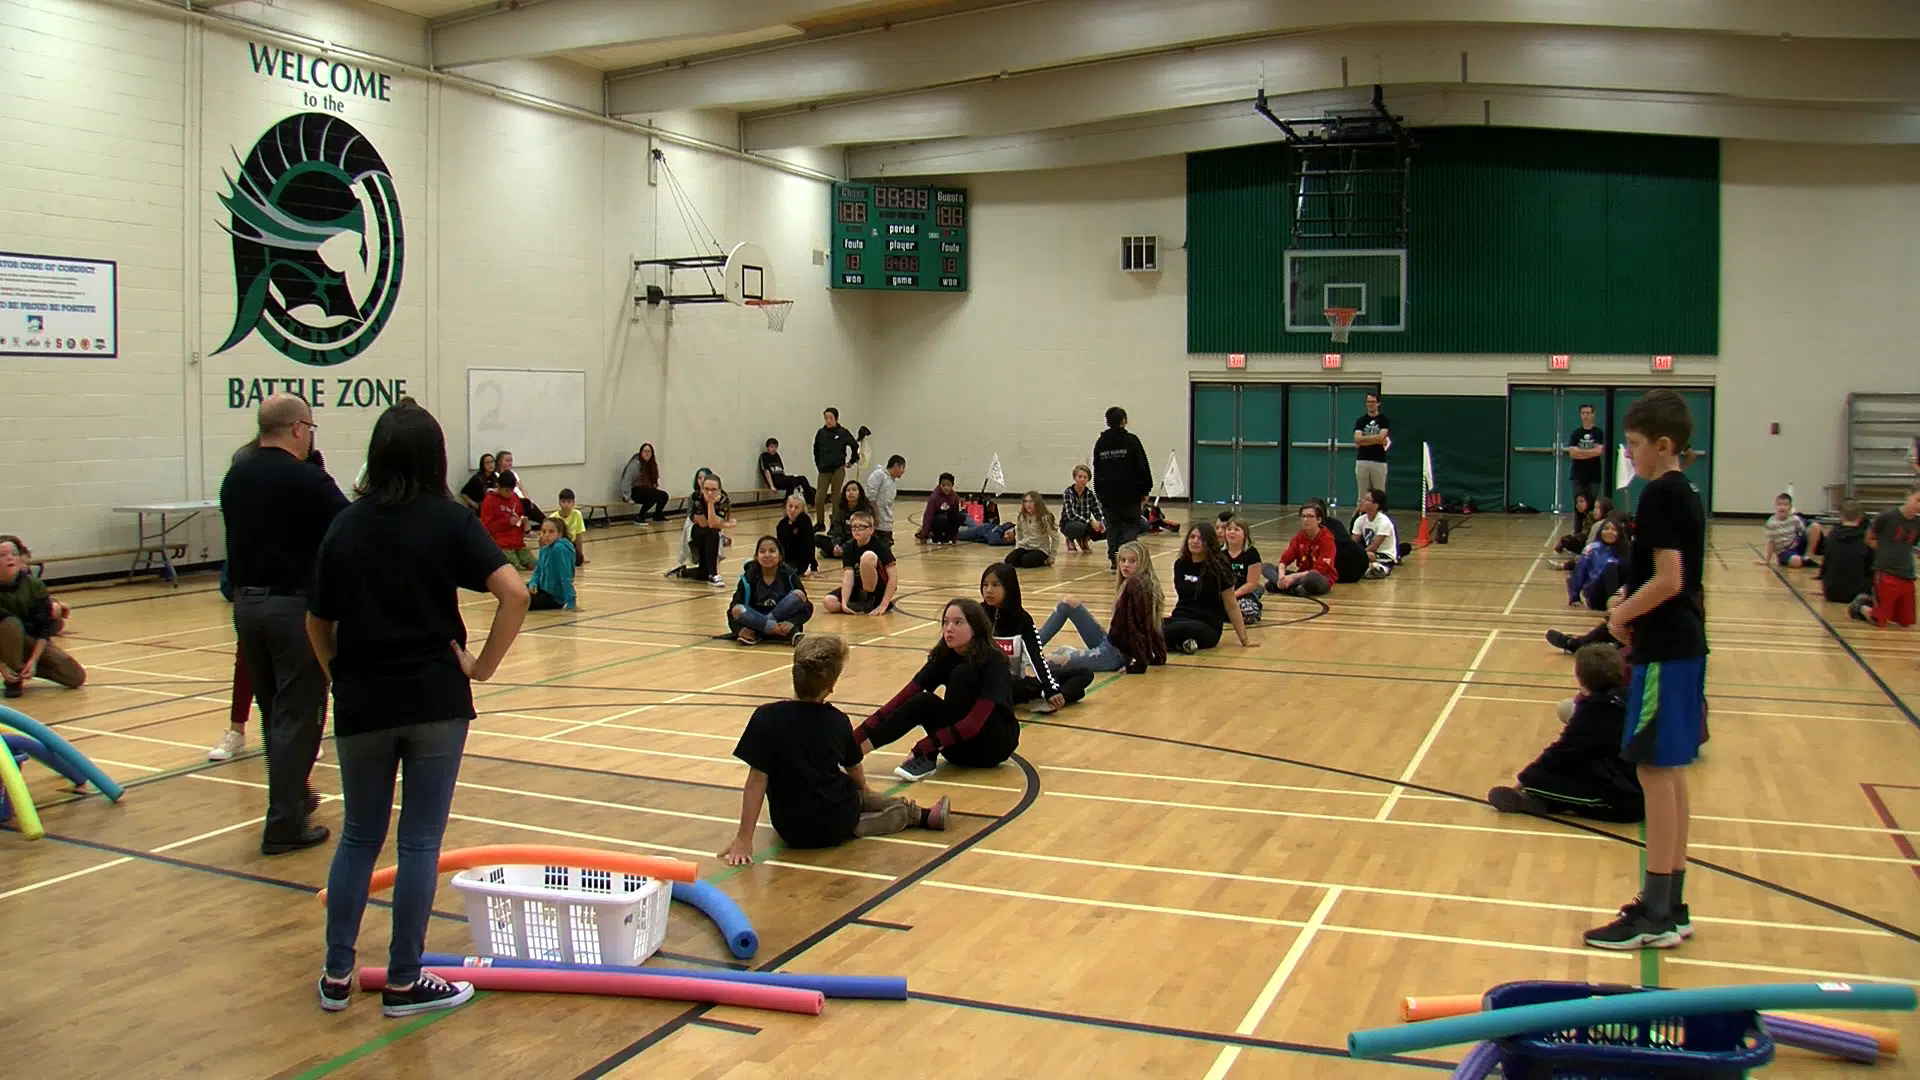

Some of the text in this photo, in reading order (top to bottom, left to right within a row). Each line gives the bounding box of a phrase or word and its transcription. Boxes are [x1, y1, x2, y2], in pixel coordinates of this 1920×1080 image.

[248, 41, 391, 102] WELCOME
[304, 92, 344, 112] to the
[889, 225, 915, 234] period
[844, 239, 864, 249] fouls
[889, 240, 915, 251] player
[941, 242, 960, 253] fouls
[21, 262, 43, 270] CODE
[58, 265, 96, 274] CONDUCT
[845, 275, 862, 284] won
[892, 276, 912, 286] game
[942, 278, 958, 286] won
[21, 302, 48, 311] PROUD
[61, 304, 96, 313] POSITIVE
[1229, 355, 1244, 367] EXIT
[1325, 355, 1340, 367] EXIT
[337, 378, 406, 408] ZONE
